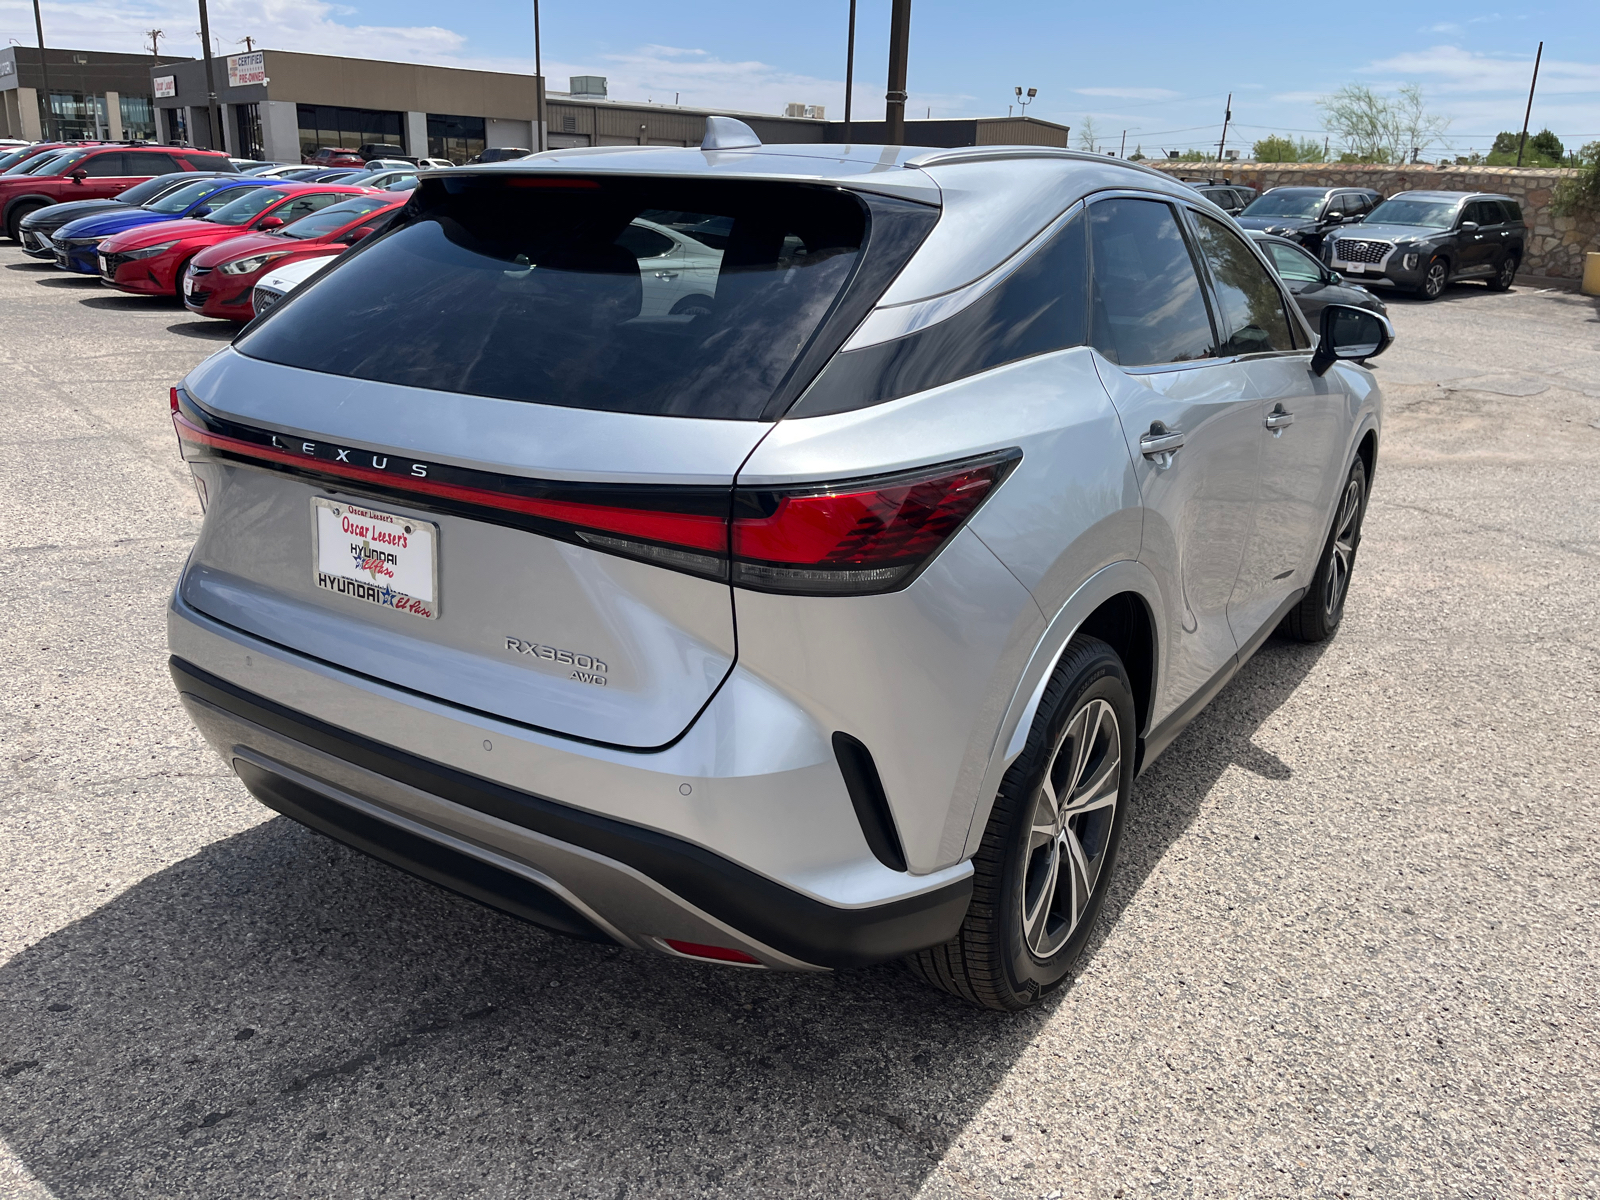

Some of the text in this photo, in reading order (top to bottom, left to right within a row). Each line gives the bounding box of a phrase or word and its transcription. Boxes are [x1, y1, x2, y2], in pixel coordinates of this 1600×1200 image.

[238, 54, 262, 66] CERTIFIED
[239, 71, 265, 83] PRE-OWNED
[272, 435, 428, 478] LEXUS
[348, 505, 394, 524] Oscar Leeser's
[342, 516, 408, 549] Oscar Leeser's
[350, 543, 398, 566] HYUNDAI
[318, 572, 380, 603] HYUNDAI
[395, 597, 410, 610] El
[409, 601, 431, 618] Paso
[570, 670, 607, 687] AWD
